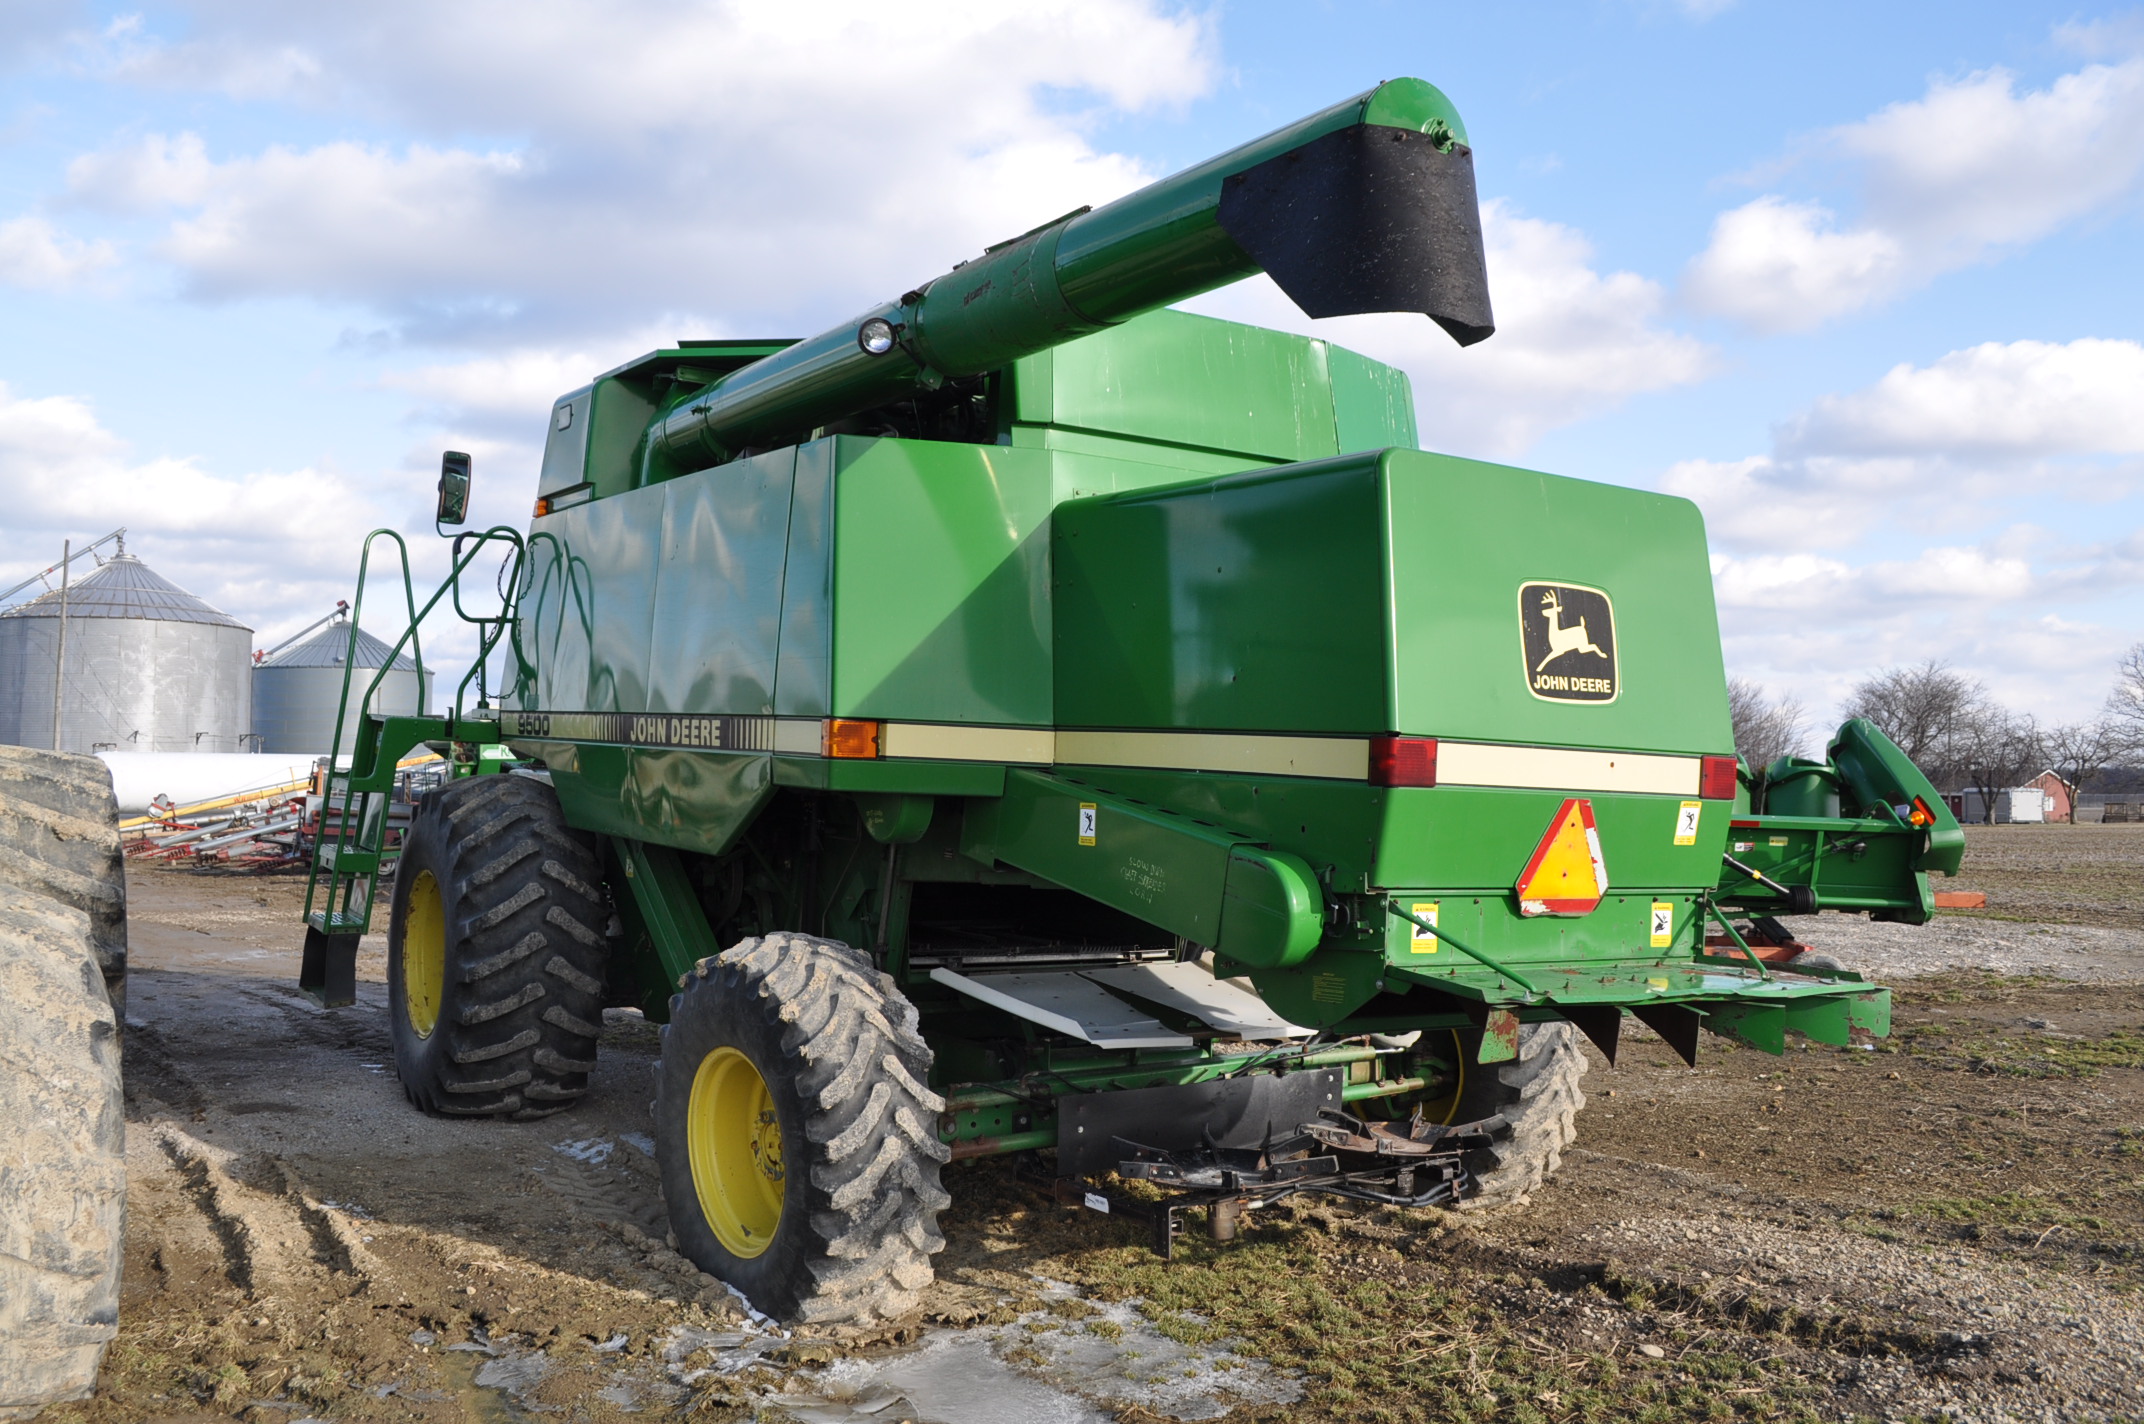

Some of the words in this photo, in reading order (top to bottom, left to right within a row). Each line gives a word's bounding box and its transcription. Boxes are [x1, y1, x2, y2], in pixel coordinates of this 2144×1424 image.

[1533, 674, 1569, 691] JOHN
[1570, 677, 1612, 693] DEERE
[518, 714, 549, 736] 9500
[630, 717, 667, 743] JOHN
[671, 718, 721, 747] DEERE
